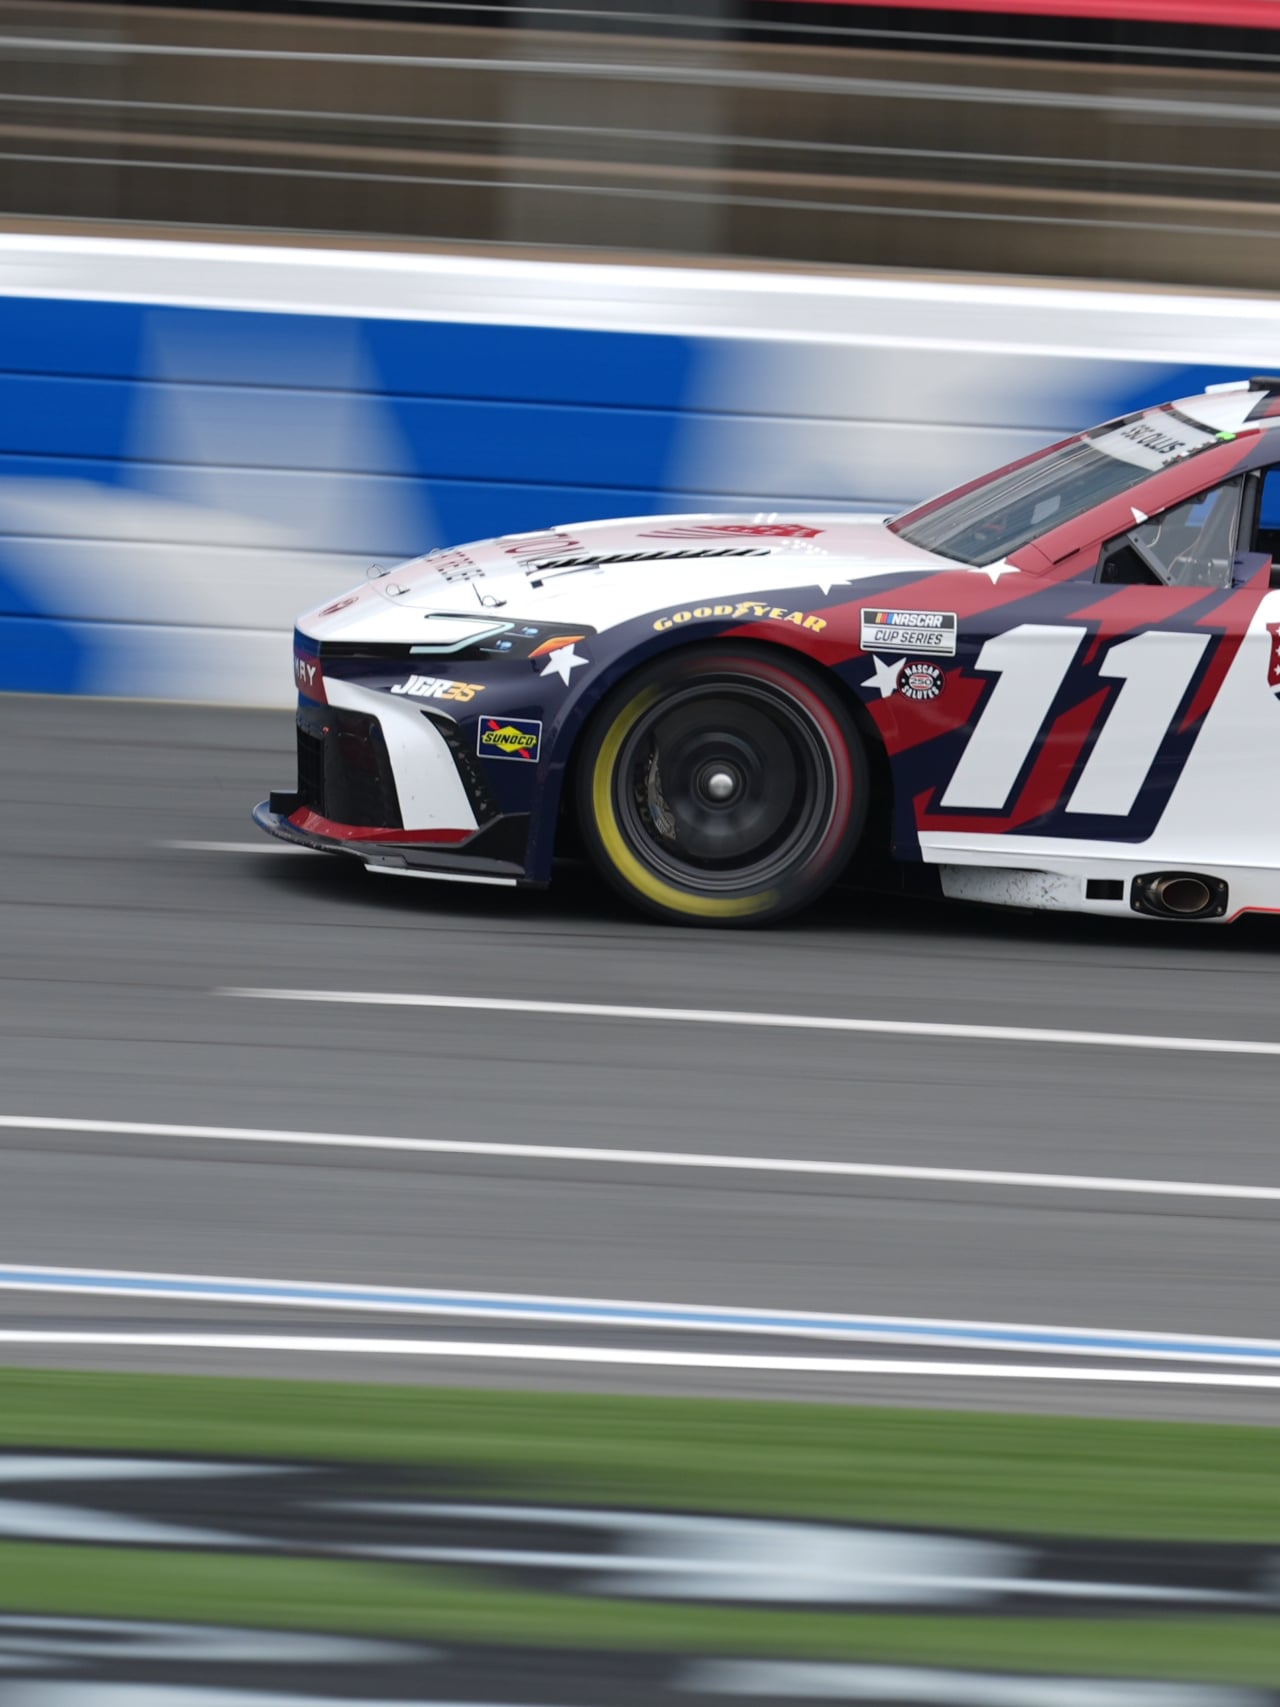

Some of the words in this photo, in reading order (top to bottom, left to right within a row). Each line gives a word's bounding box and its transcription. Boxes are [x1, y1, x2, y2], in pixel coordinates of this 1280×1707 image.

[653, 601, 827, 632] GOODYEAR
[892, 613, 943, 628] NASCAR
[874, 630, 898, 642] CUP
[900, 632, 943, 645] SERIES
[904, 665, 940, 679] NASCAR
[901, 685, 939, 700] SALUTES
[939, 623, 1213, 817] 11
[484, 732, 538, 747] SUNOCO
